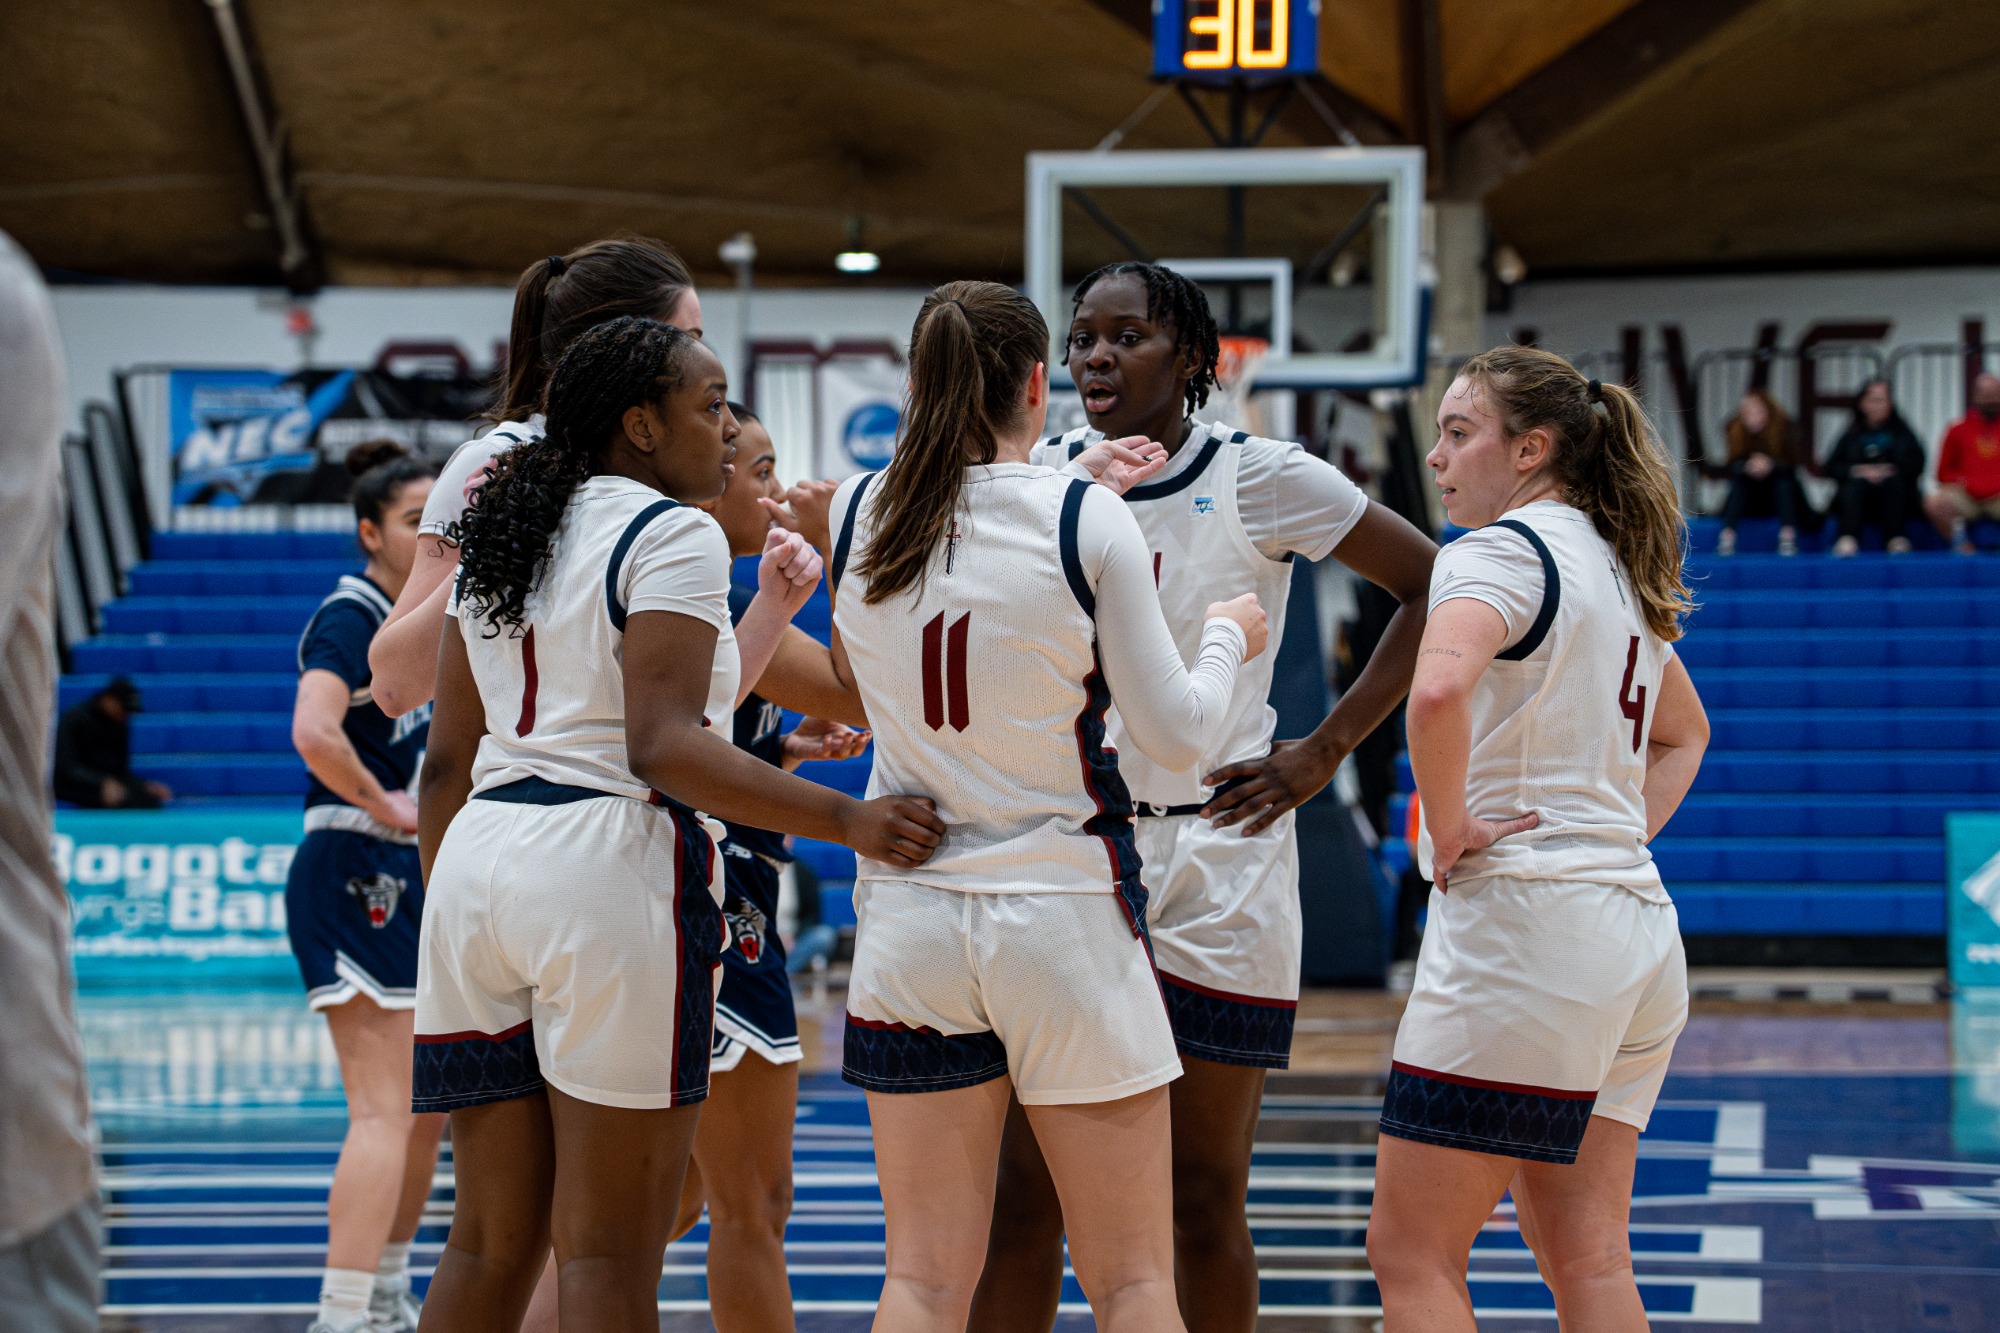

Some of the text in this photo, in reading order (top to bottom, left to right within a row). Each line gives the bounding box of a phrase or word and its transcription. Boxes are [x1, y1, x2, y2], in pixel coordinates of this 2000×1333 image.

[1183, 0, 1288, 69] 30
[181, 408, 312, 471] NEC
[922, 610, 970, 733] 11
[1619, 635, 1646, 754] 4
